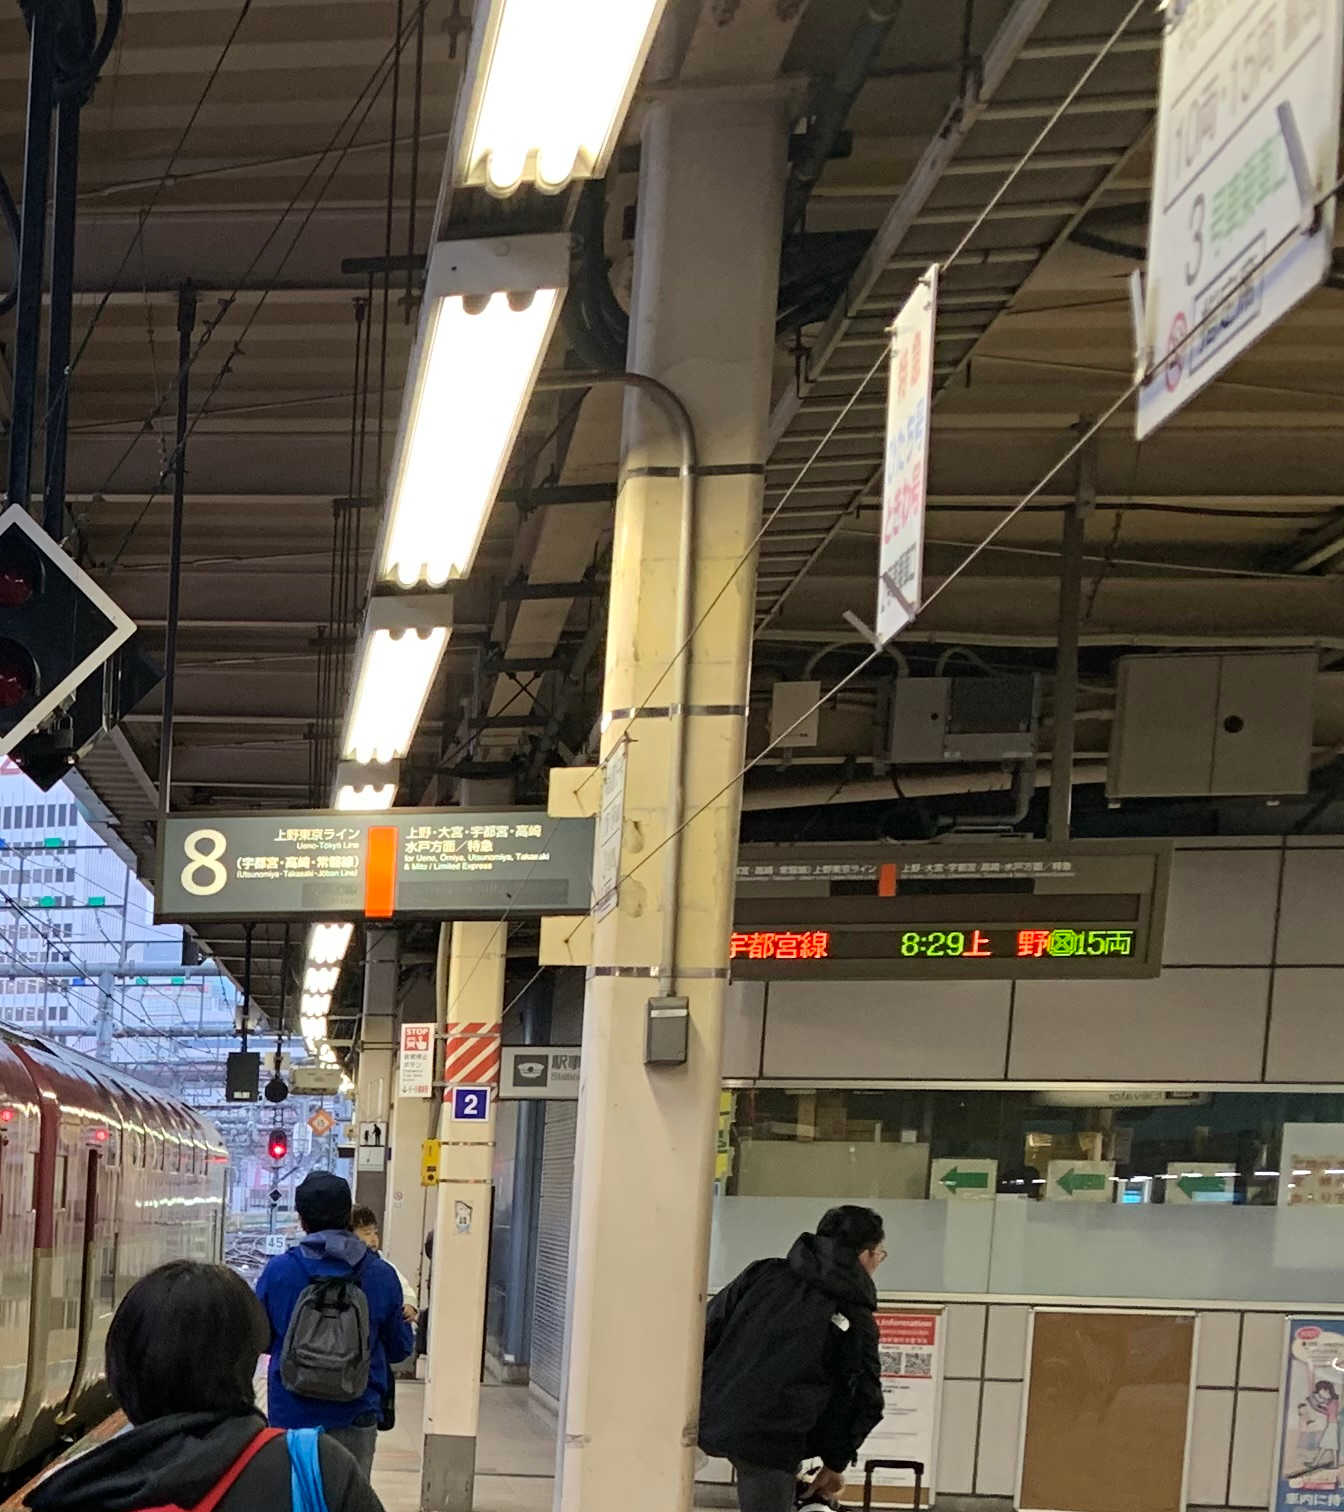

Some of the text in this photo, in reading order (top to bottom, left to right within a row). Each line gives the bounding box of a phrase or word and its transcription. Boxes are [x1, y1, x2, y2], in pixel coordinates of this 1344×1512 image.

[274, 828, 361, 842] 上野東京ライン
[180, 828, 228, 896] 8
[729, 930, 829, 959] 宇都宮線
[406, 1027, 429, 1037] STOP
[464, 1094, 479, 1115] 2
